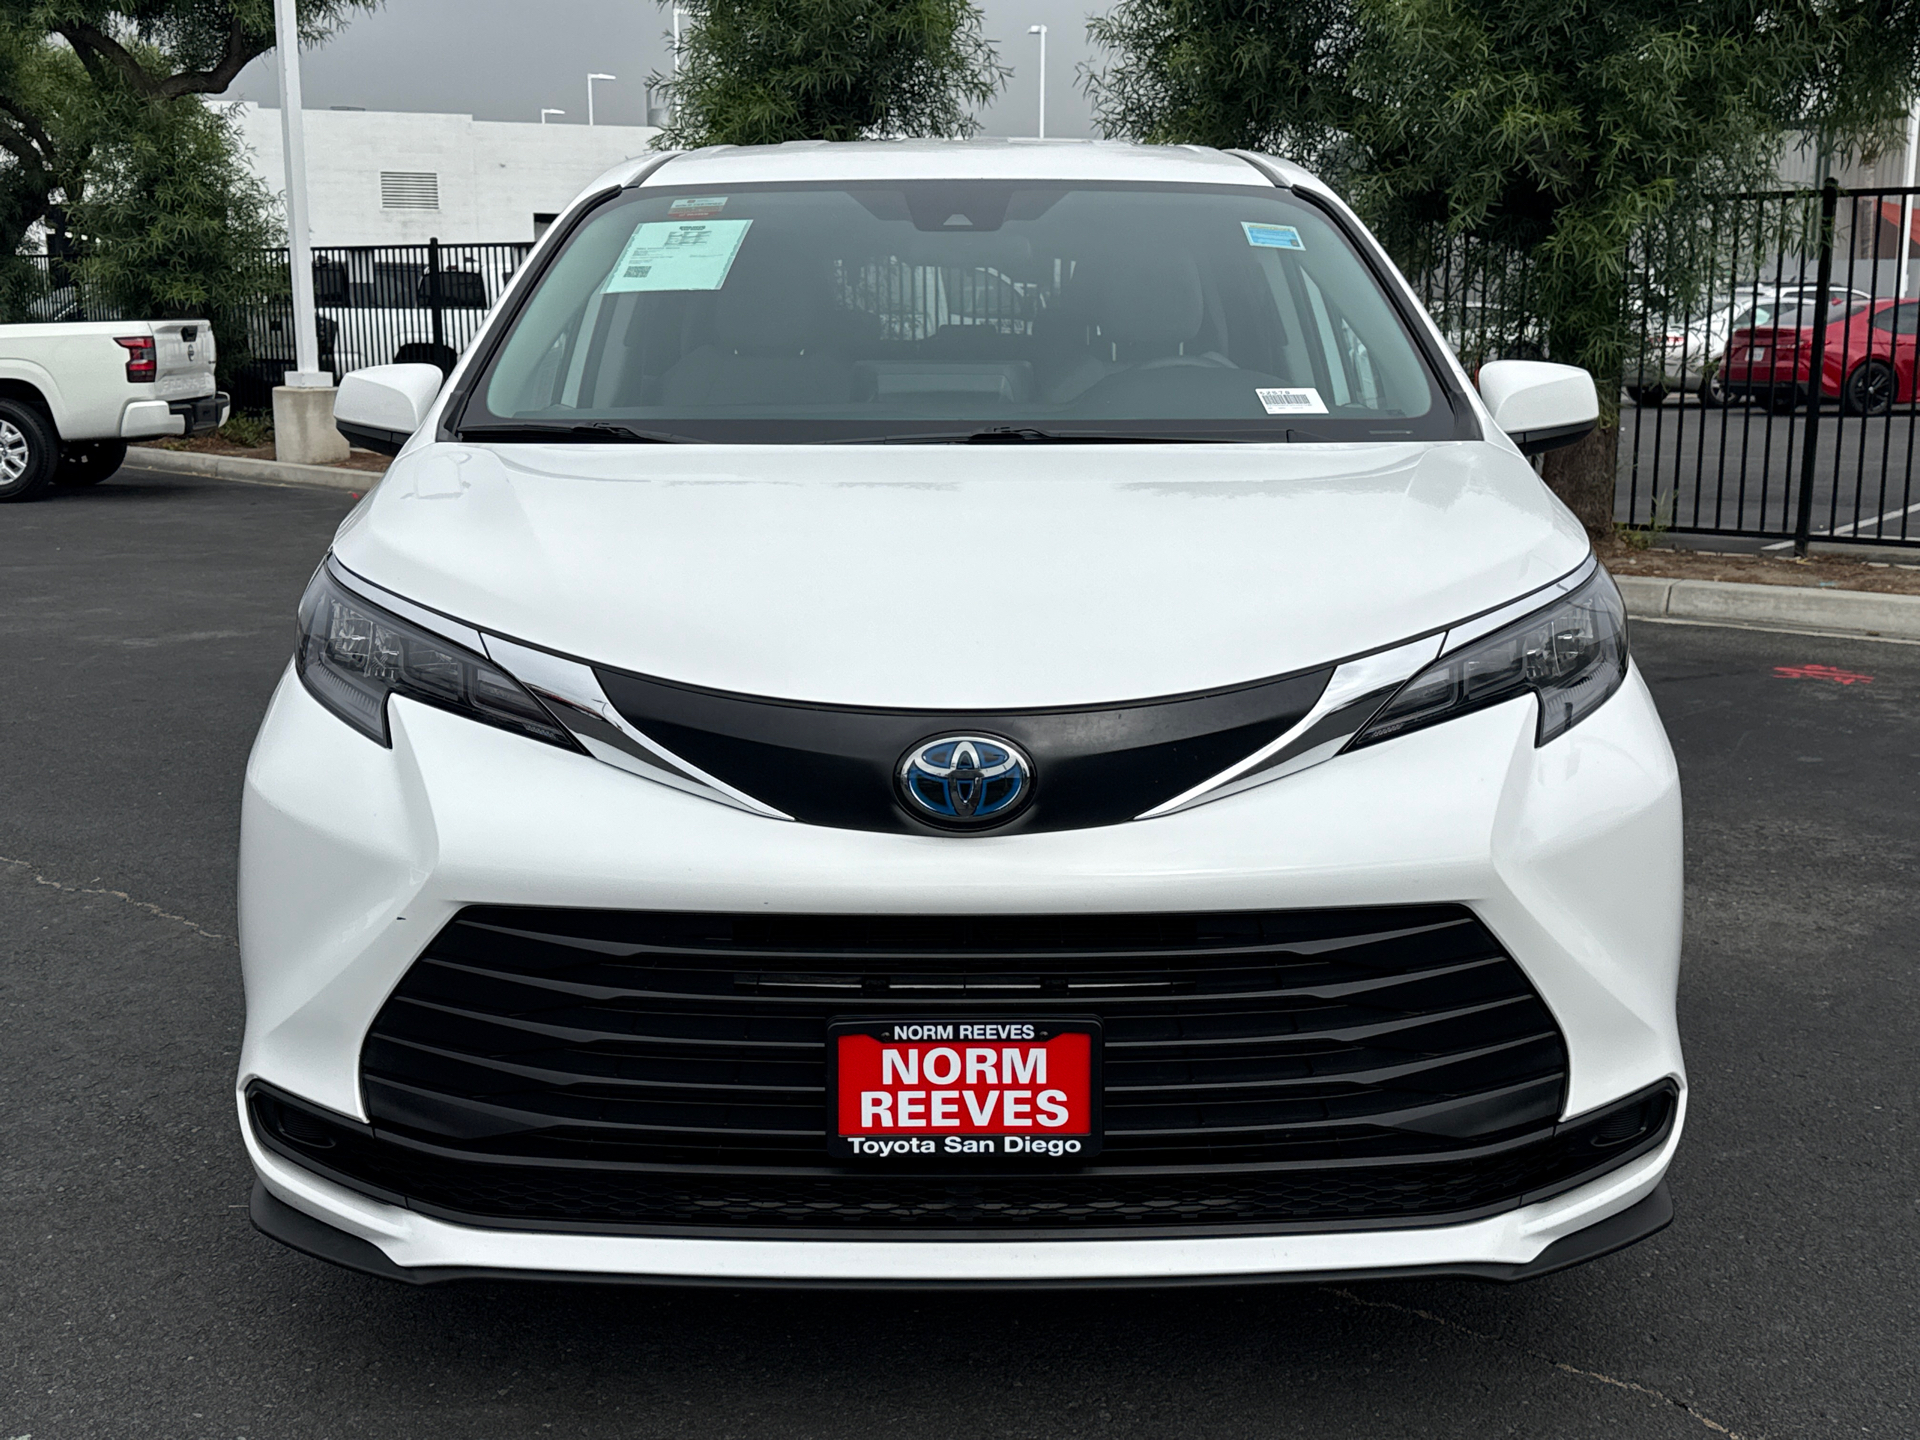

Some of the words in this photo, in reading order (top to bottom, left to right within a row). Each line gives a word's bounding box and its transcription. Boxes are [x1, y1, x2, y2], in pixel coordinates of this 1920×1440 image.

[893, 1025, 954, 1039] NORM
[959, 1025, 1035, 1039] REEVES
[882, 1047, 1047, 1085] NORM
[861, 1089, 1069, 1128] REEVES
[847, 1137, 936, 1156] Toyota
[944, 1136, 995, 1153] San
[1004, 1136, 1082, 1156] Diego
